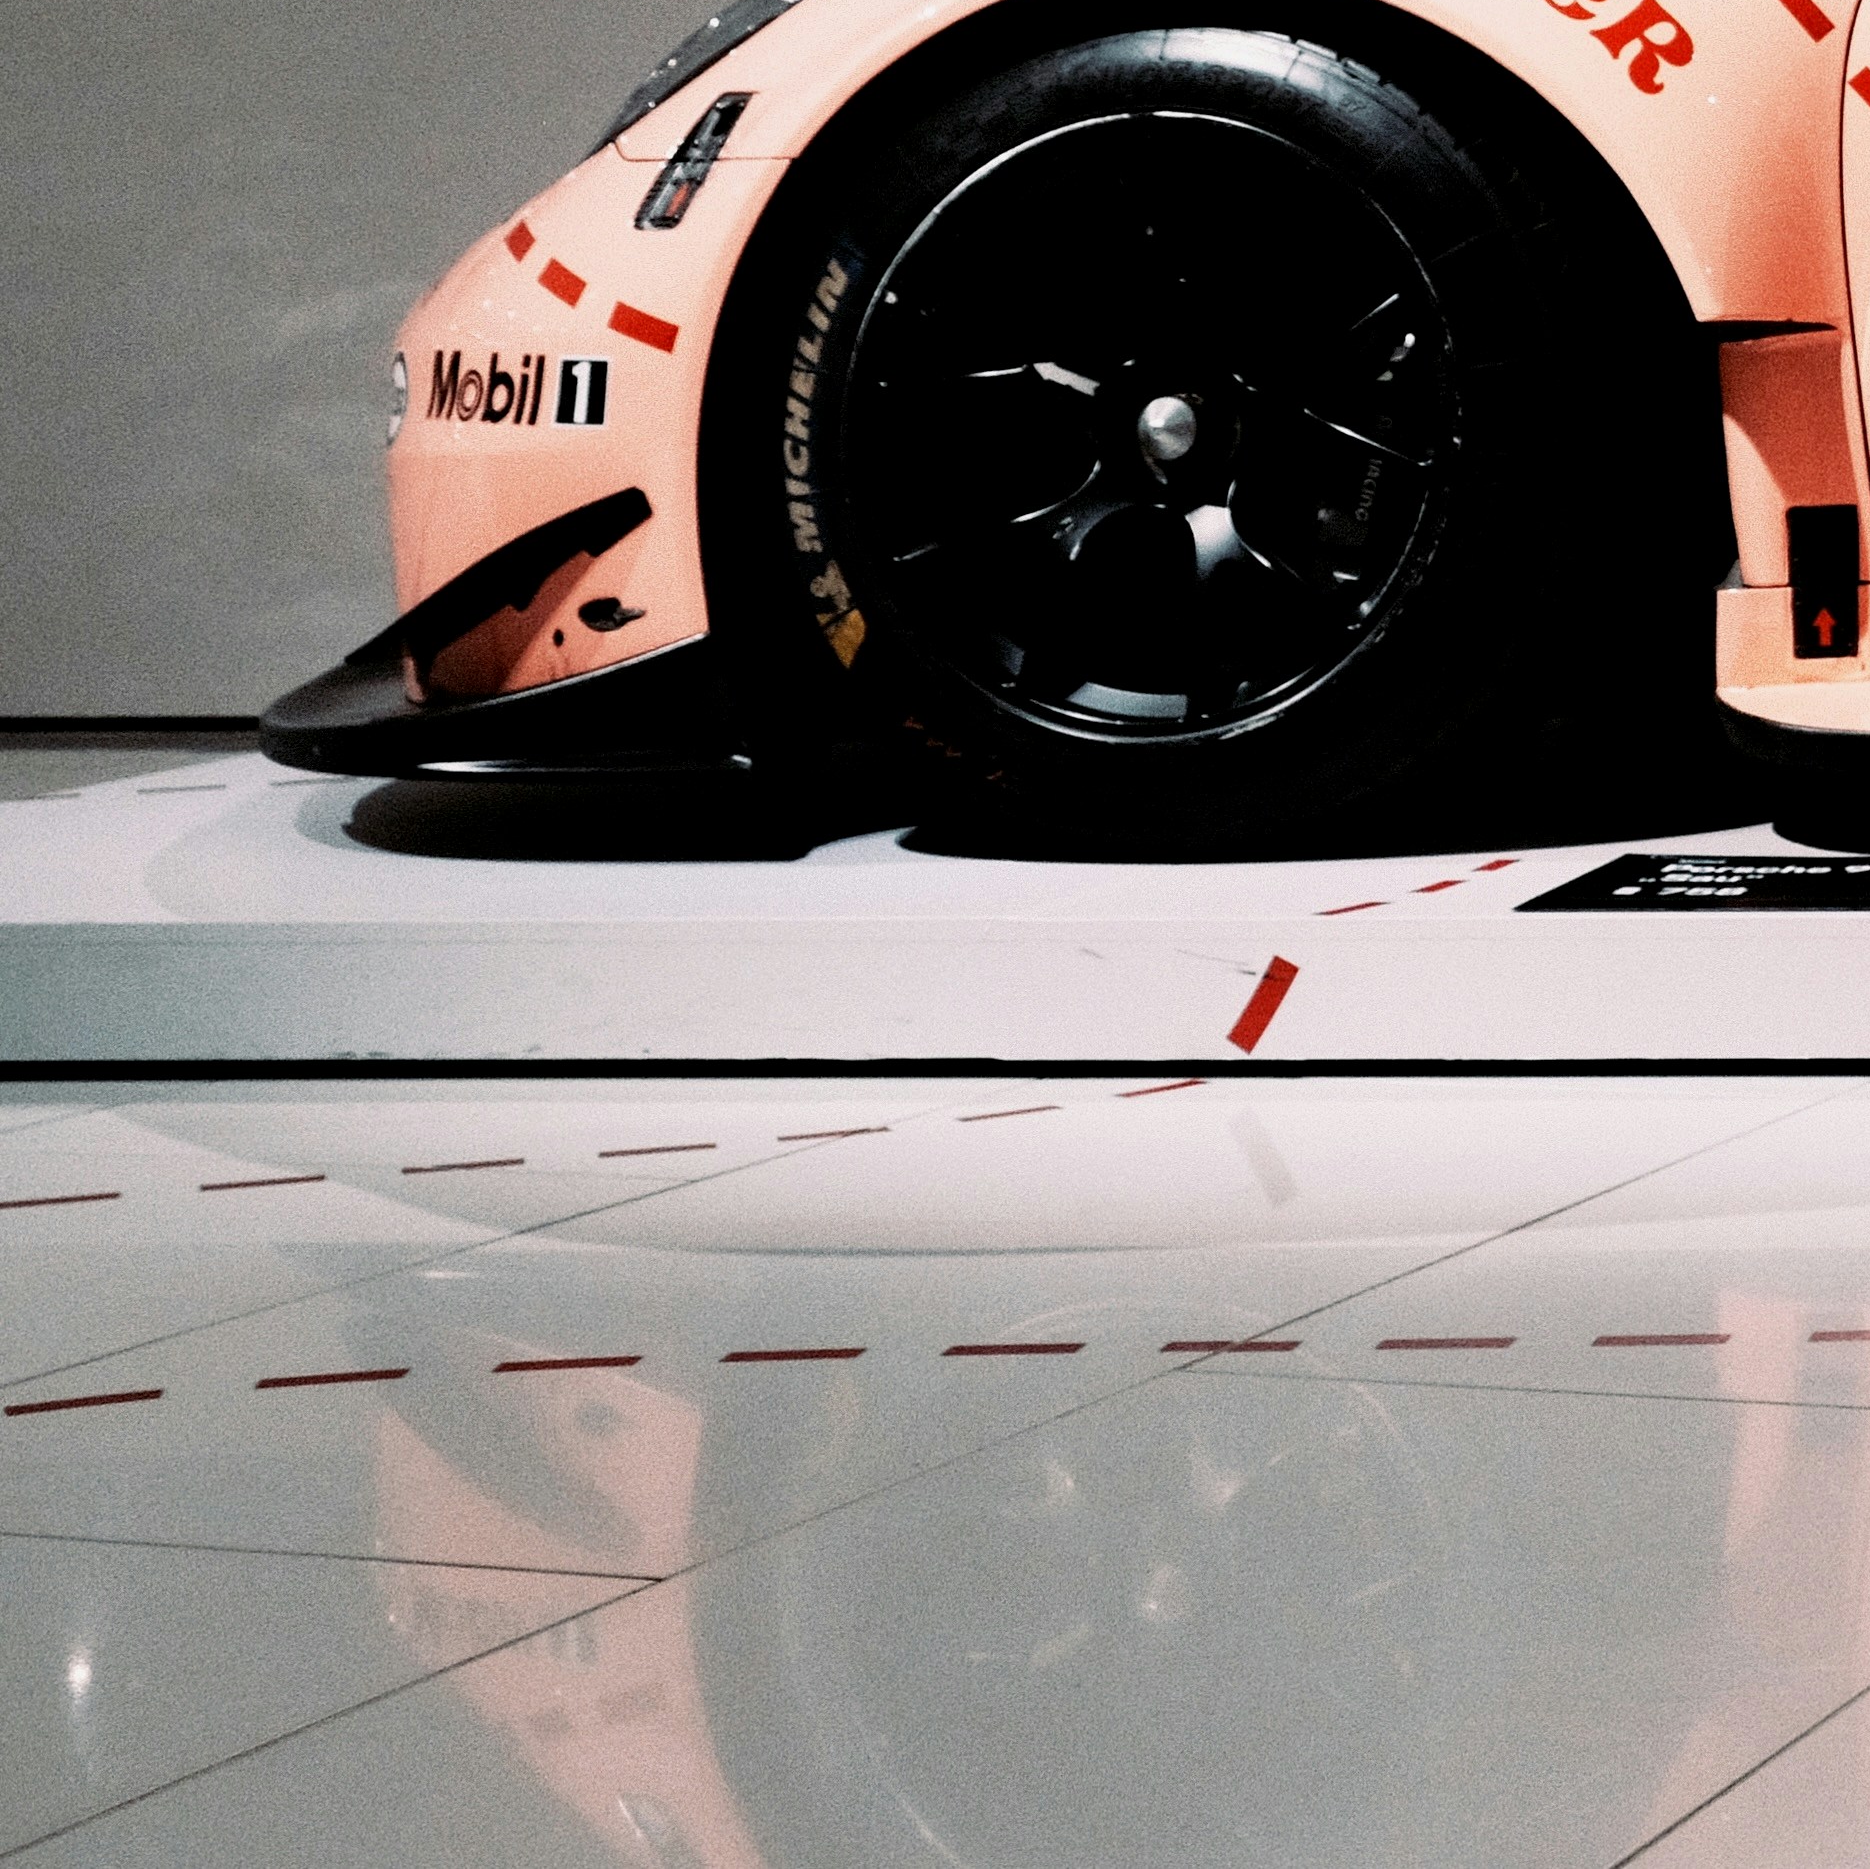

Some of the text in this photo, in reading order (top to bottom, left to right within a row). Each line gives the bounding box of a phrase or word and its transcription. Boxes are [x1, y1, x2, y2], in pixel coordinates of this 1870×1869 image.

[426, 350, 545, 426] Mobil
[570, 361, 594, 424] 1
[783, 259, 848, 552] MICHELIN
[1660, 862, 1832, 875] Porsche
